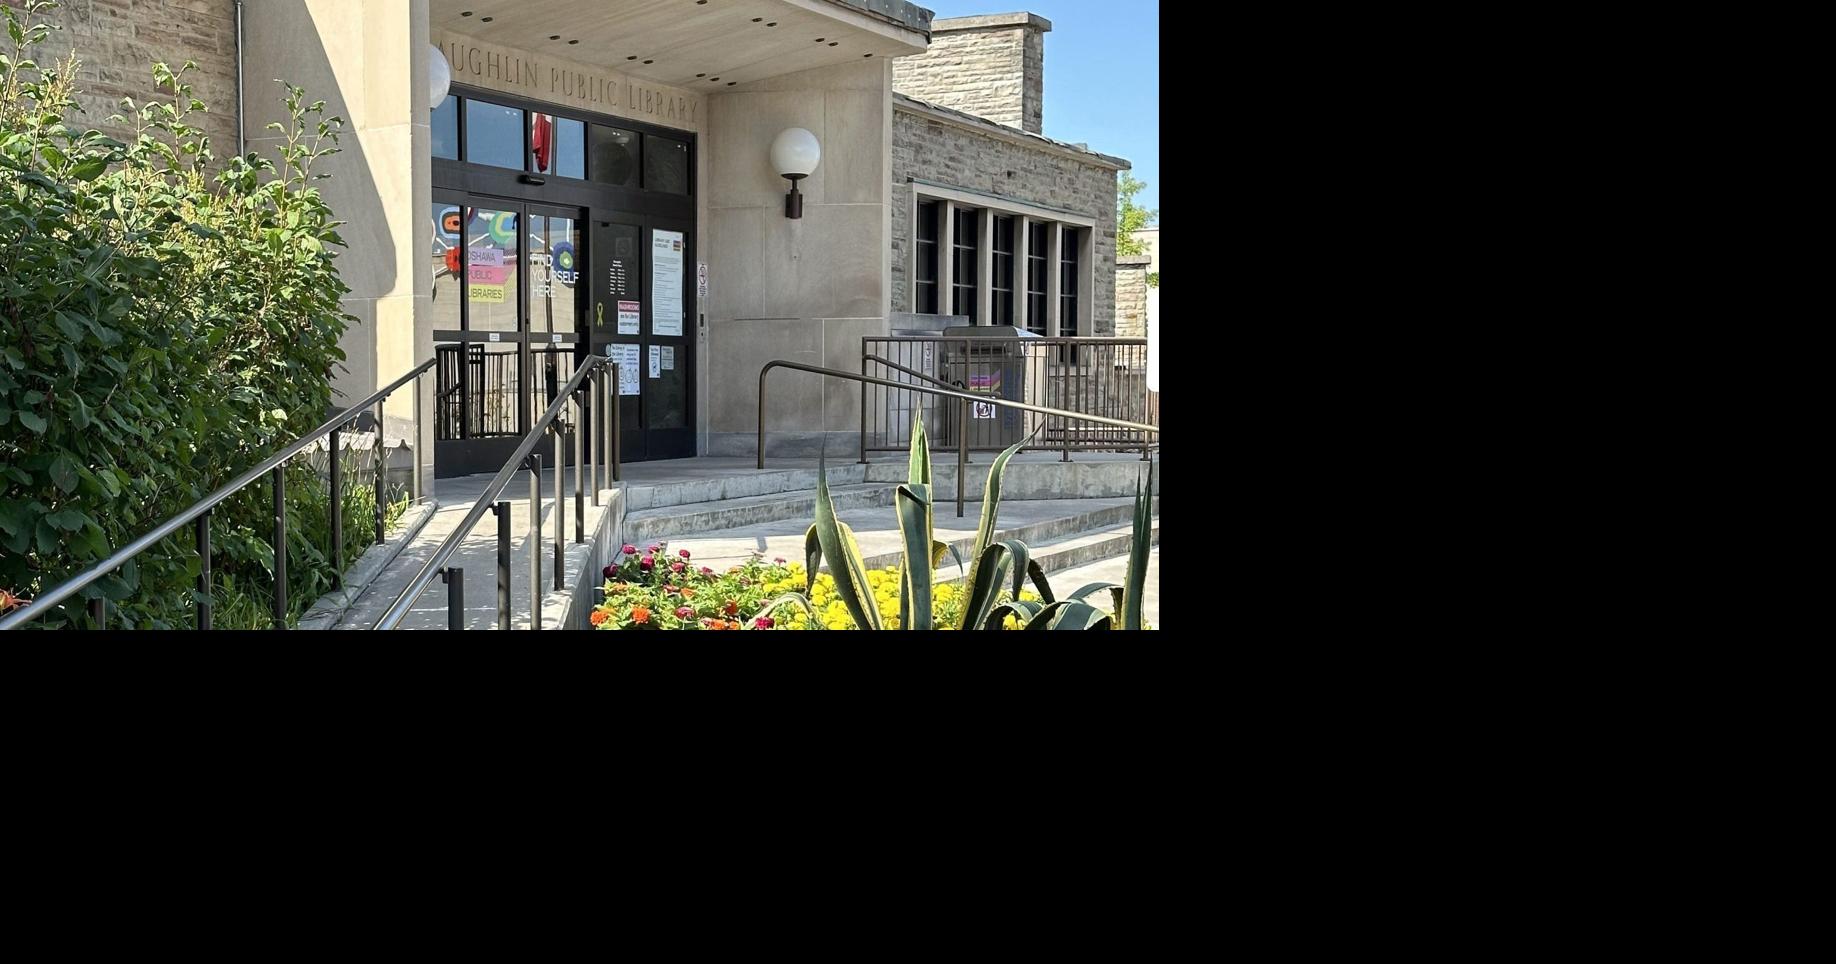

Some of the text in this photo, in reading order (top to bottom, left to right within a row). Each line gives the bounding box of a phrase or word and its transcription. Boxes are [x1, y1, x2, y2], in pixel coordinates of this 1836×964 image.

[551, 68, 617, 106] PUBLIC
[630, 85, 697, 123] LIBRARY
[532, 270, 579, 284] YOURSELF
[533, 285, 556, 298] HERE
